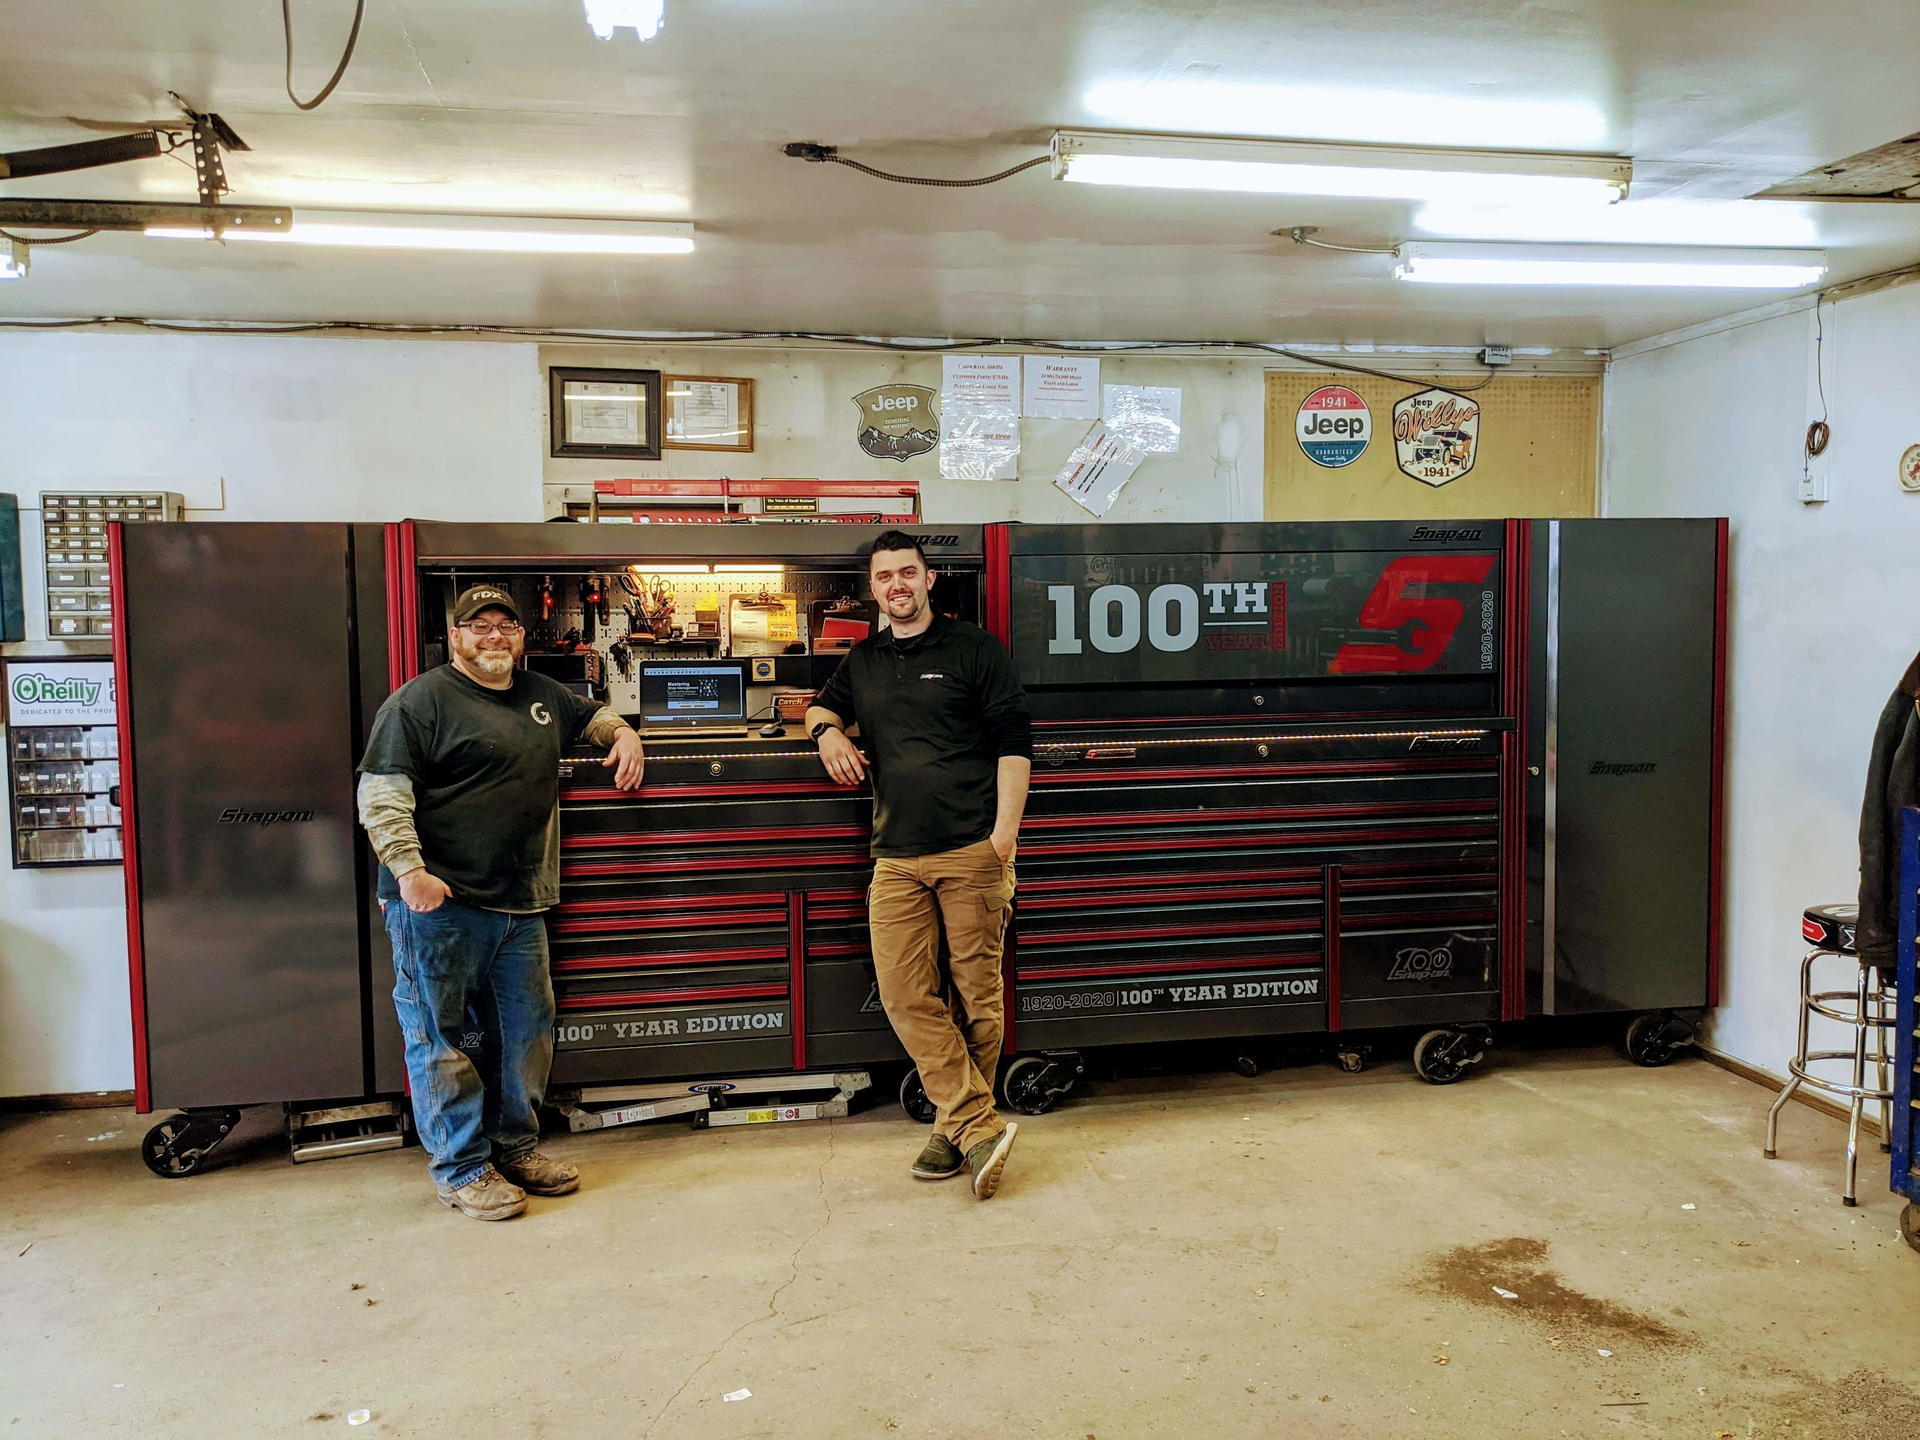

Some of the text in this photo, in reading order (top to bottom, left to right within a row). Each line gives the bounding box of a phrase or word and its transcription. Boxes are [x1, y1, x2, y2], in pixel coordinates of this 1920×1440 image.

[871, 394, 918, 412] Jeep
[1322, 397, 1346, 407] 1941
[1411, 398, 1433, 408] Jeep
[1304, 413, 1364, 438] Jeep
[1394, 398, 1480, 444] Willys
[1424, 467, 1450, 477] 1941
[1410, 526, 1483, 544] Snap-on
[1273, 584, 1286, 649] EDITION
[1481, 590, 1494, 670] 1920-2020
[1205, 633, 1268, 650] YEAR
[15, 676, 98, 703] O'Reilly
[1587, 761, 1656, 776] Snap-on
[217, 808, 314, 826] Snap-on
[1022, 992, 1114, 1012] 1920-2020
[1169, 985, 1227, 1002] YEAR
[1233, 980, 1318, 998] EDITION
[613, 1019, 679, 1038] YEAR
[686, 1013, 784, 1034] EDITION
